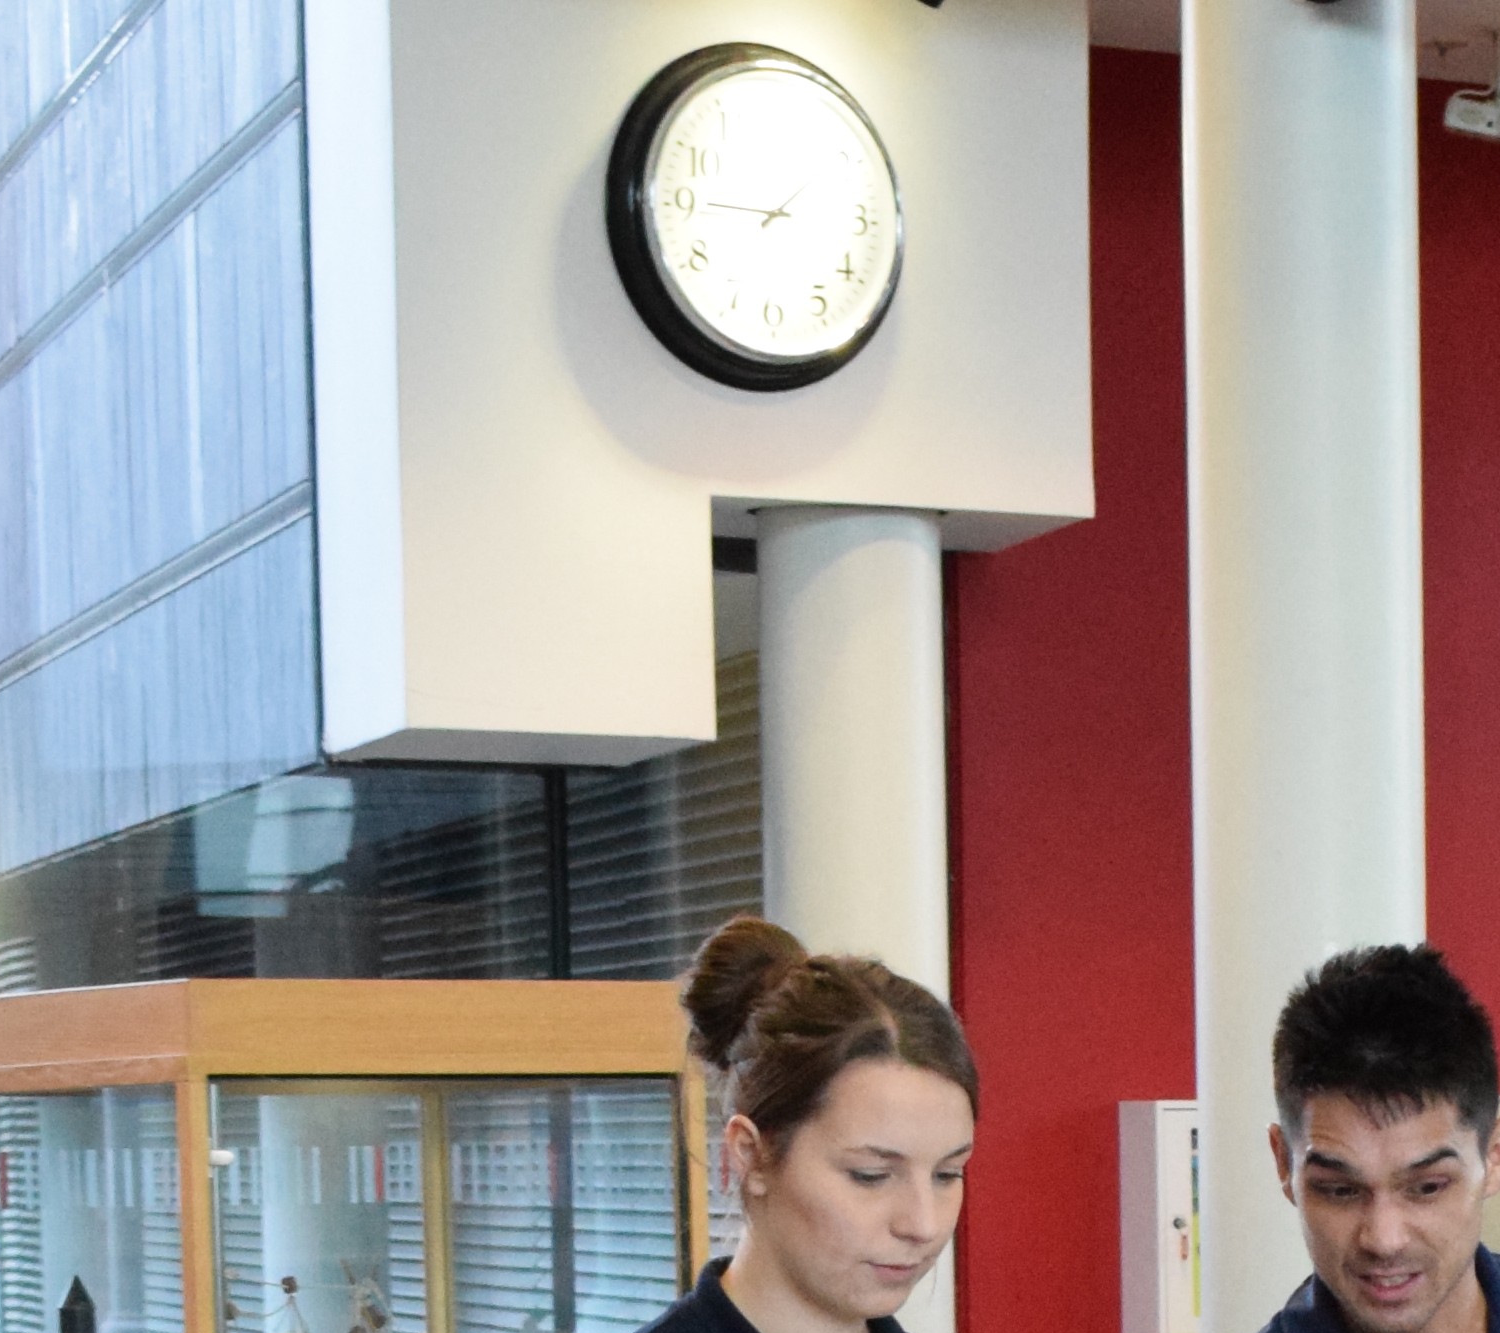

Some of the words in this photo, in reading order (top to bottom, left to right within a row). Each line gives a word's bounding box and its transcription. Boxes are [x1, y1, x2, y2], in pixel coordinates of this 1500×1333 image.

[688, 146, 720, 178] 10
[675, 186, 696, 222] 9
[689, 239, 709, 272] 8
[836, 250, 855, 281] 4
[763, 296, 784, 327] 6
[811, 285, 828, 318] 5
